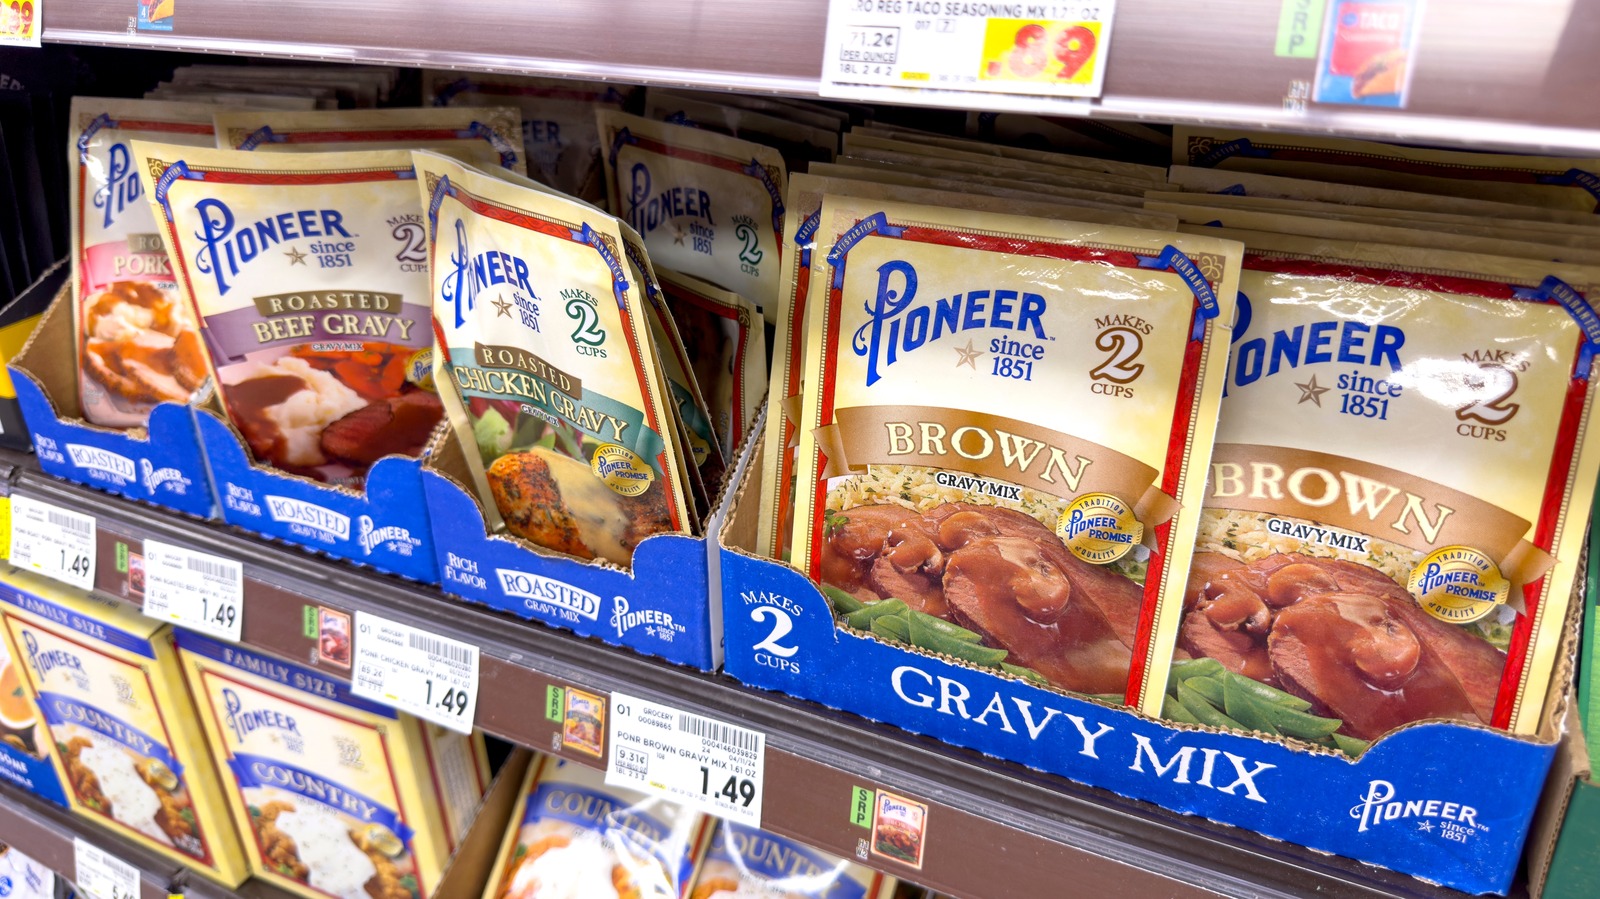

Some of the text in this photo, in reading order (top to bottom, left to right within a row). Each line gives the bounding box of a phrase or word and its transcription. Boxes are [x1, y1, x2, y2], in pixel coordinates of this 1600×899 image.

[877, 0, 1099, 20] REG TACO SEASONING MX OZ
[987, 24, 1096, 80] .89
[626, 162, 714, 242] PIONEER
[392, 223, 427, 263] 2
[690, 220, 714, 241] since
[735, 223, 763, 266] 2
[194, 198, 353, 297] PIONEER
[310, 240, 356, 254] since
[588, 230, 624, 283] GUARANTEED
[692, 236, 713, 256] 1851
[113, 255, 171, 277] PORK
[317, 254, 353, 268] 1851
[740, 263, 760, 277] CUPS
[1170, 253, 1216, 311] GUARANTEED
[271, 293, 390, 314] ROASTED
[513, 291, 540, 317] since
[559, 288, 599, 308] MAKES
[251, 313, 416, 344] BEEF GRAVY
[519, 308, 541, 334] 1851
[565, 298, 606, 347] 2
[852, 259, 1049, 387] PIONEER
[1094, 314, 1154, 336] MAKES
[576, 344, 608, 359] CUPS
[989, 334, 1044, 361] since
[1089, 326, 1146, 385] 2
[482, 346, 571, 392] ROASTED
[991, 355, 1034, 382] 1851
[1090, 382, 1135, 399] CUPS
[1337, 370, 1404, 398] since
[1455, 362, 1521, 427] 2
[453, 366, 629, 444] CHICKEN GRAVY
[1339, 393, 1390, 421] 1851
[1456, 423, 1508, 442] CUPS
[71, 446, 134, 477] ROASTED
[598, 456, 634, 478] PIONEER
[885, 422, 1093, 493] BROWN
[140, 458, 184, 495] PIONEER
[615, 470, 648, 480] PROMISE
[936, 472, 1021, 501] GRAVY MIX
[226, 482, 254, 501] RICH
[226, 494, 262, 517] FLAVOR
[1212, 462, 1455, 545] BROWN
[273, 499, 347, 534] ROASTED
[1079, 498, 1125, 516] TRADITION
[290, 524, 336, 545] GRAVY MIX
[358, 514, 411, 556] PIONEER
[1064, 509, 1117, 540] PIONEER
[1088, 529, 1133, 544] PROMISE
[1268, 519, 1368, 553] GRAVY MIX
[61, 549, 90, 578] 1.49
[447, 552, 478, 574] RICH
[1081, 549, 1116, 560] QUALITY
[1436, 551, 1489, 571] TRADITION
[446, 565, 487, 590] FLAVOR
[1417, 562, 1479, 595] PIONEER
[503, 572, 597, 615] ROASTED
[740, 590, 804, 617] MAKES
[1445, 584, 1497, 602] PROMISE
[17, 592, 68, 624] FAMILY
[72, 615, 107, 640] SIZE
[202, 597, 236, 628] 1.49
[524, 599, 580, 623] GRAVY MIX
[610, 595, 674, 638] PIONEER
[1436, 606, 1476, 618] QUALITY
[656, 625, 676, 637] since
[750, 606, 799, 658] 2
[22, 630, 87, 683] PIONEER
[754, 653, 801, 674] CUPS
[224, 648, 290, 683] FAMILY
[295, 669, 337, 699] SIZE
[425, 678, 469, 717] 1.49
[617, 704, 631, 717] 01
[55, 700, 153, 752] COUNTRY
[222, 688, 301, 744] PIONEER
[643, 707, 674, 721] GROCERY
[702, 738, 758, 760] 0004146039829
[891, 665, 1277, 806] GRAVY MIX
[617, 730, 757, 778] PONR BROWN GRAVY MIX 1.61 OZ
[619, 749, 645, 764] 9.31¢
[702, 746, 711, 754] 24
[728, 755, 756, 767] 04/11/24
[251, 762, 378, 822] COUNTRY
[700, 766, 756, 808] 1.49
[856, 789, 868, 824] SRP
[1350, 780, 1477, 832] PIONEER
[1440, 821, 1475, 837] since
[1441, 829, 1467, 844] 1851
